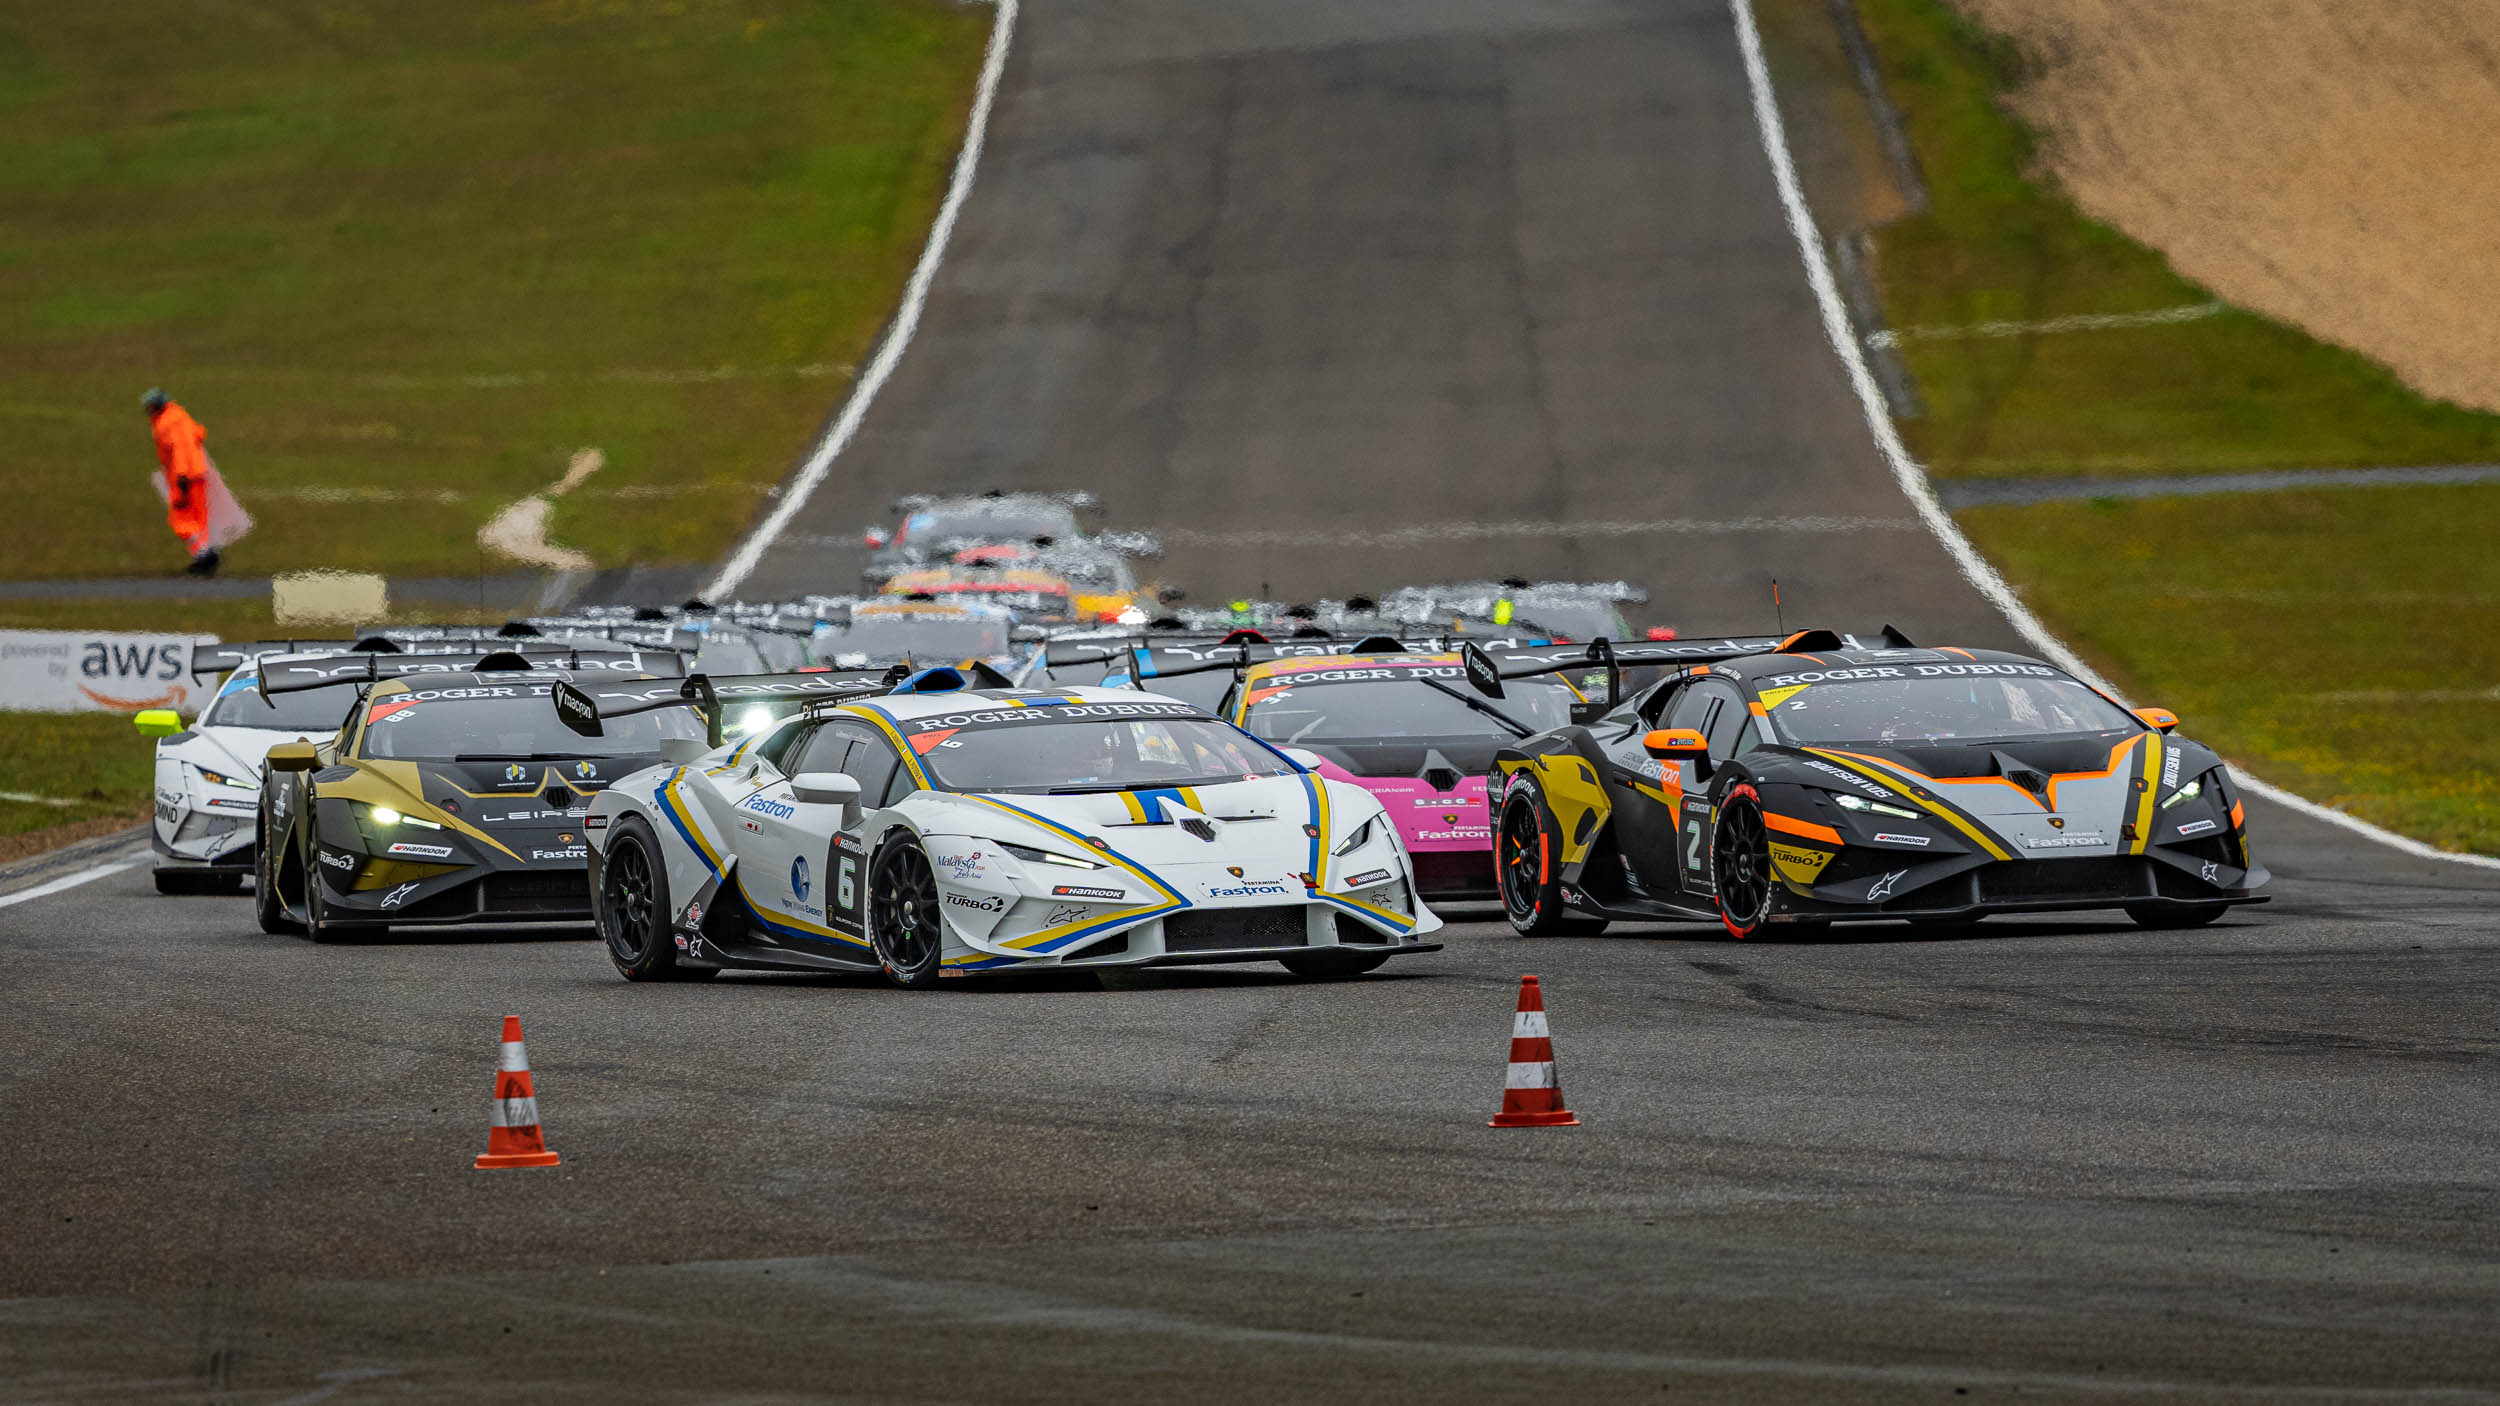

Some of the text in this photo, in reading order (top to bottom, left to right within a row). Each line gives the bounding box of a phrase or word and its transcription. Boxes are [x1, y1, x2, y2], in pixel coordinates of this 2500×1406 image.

[1273, 638, 1517, 657] ranstad
[81, 642, 183, 680] aws
[398, 652, 645, 673] ranstad
[1269, 669, 1396, 686] ROGER
[1770, 664, 2054, 687] ROGER DUBUIS
[390, 686, 518, 705] ROGER
[915, 703, 1198, 731] ROGER DUBUIS
[1802, 760, 1867, 786] BOUTSEN
[744, 794, 795, 820] Fastron
[1418, 830, 1492, 840] Fastron
[1686, 820, 1701, 871] 2
[2027, 836, 2105, 848] Fastron
[837, 855, 856, 910] 6
[1209, 885, 1286, 897] Fastron
[946, 895, 993, 911] TURBO
